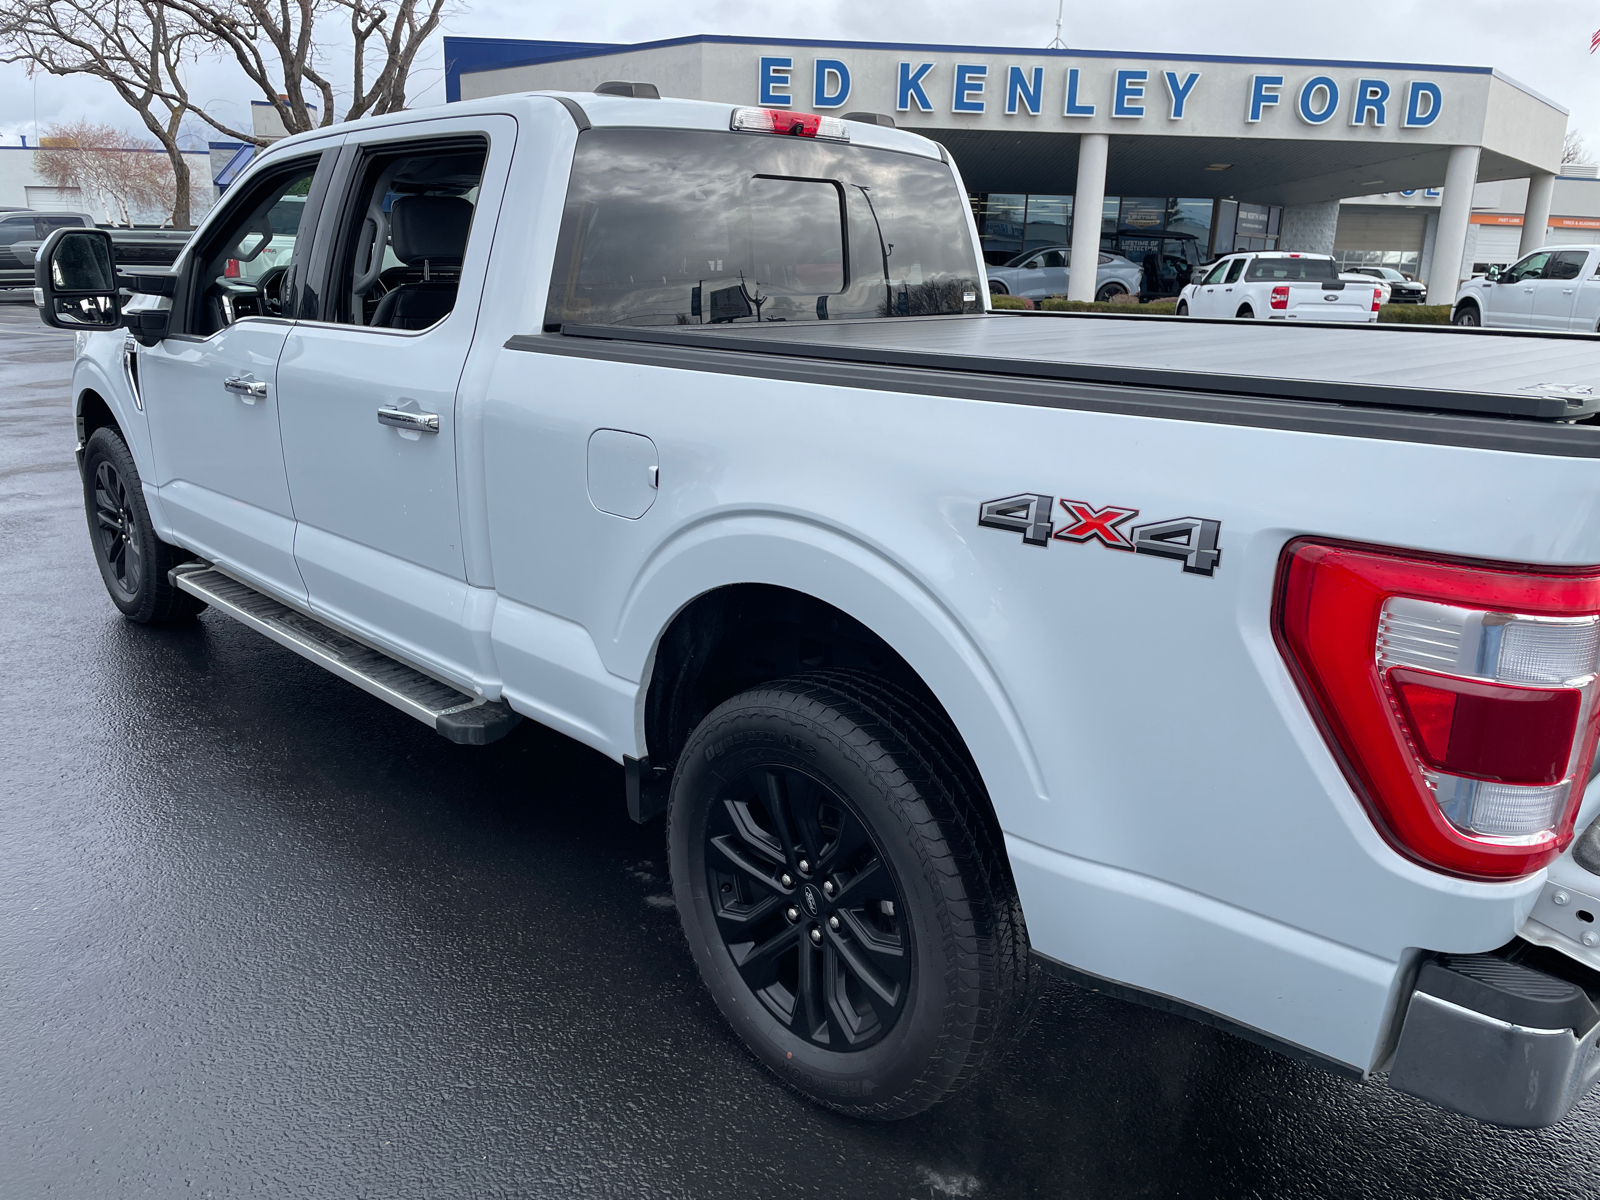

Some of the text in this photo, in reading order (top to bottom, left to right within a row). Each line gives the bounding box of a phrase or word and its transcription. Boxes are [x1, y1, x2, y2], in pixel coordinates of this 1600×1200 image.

[758, 56, 1443, 128] ED KENLEY FORD
